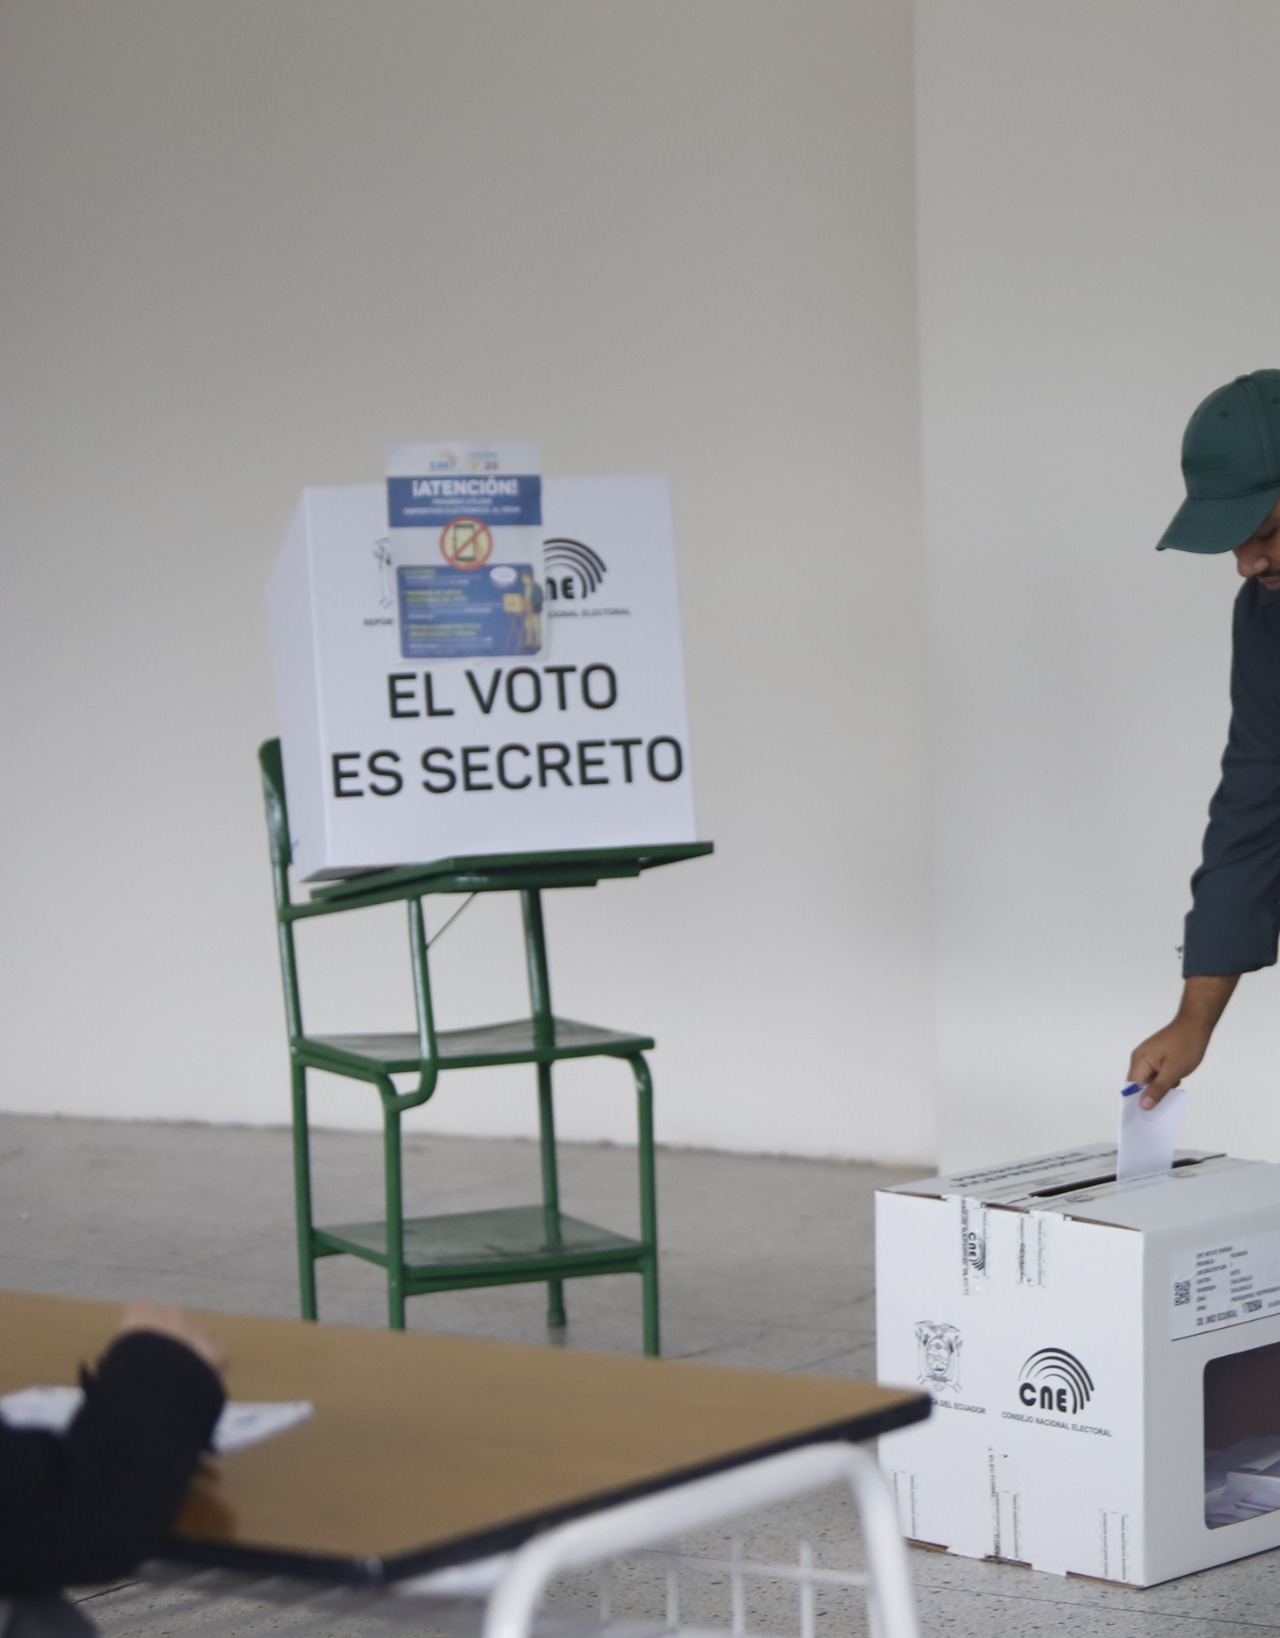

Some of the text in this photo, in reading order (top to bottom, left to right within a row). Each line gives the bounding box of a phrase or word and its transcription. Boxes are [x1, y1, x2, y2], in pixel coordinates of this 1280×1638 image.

[412, 475, 518, 497] ¡ATENCIÓN!
[546, 577, 574, 600] NE
[582, 608, 631, 616] ELECTORAL
[387, 662, 618, 719] EL VOTO
[332, 736, 683, 798] ES SECRETO
[940, 1400, 952, 1409] DEL
[954, 1402, 986, 1415] ECUADOR
[1019, 1382, 1067, 1413] CNE
[1001, 1411, 1112, 1437] CONSEJO NACIONAL ELECTORAL
